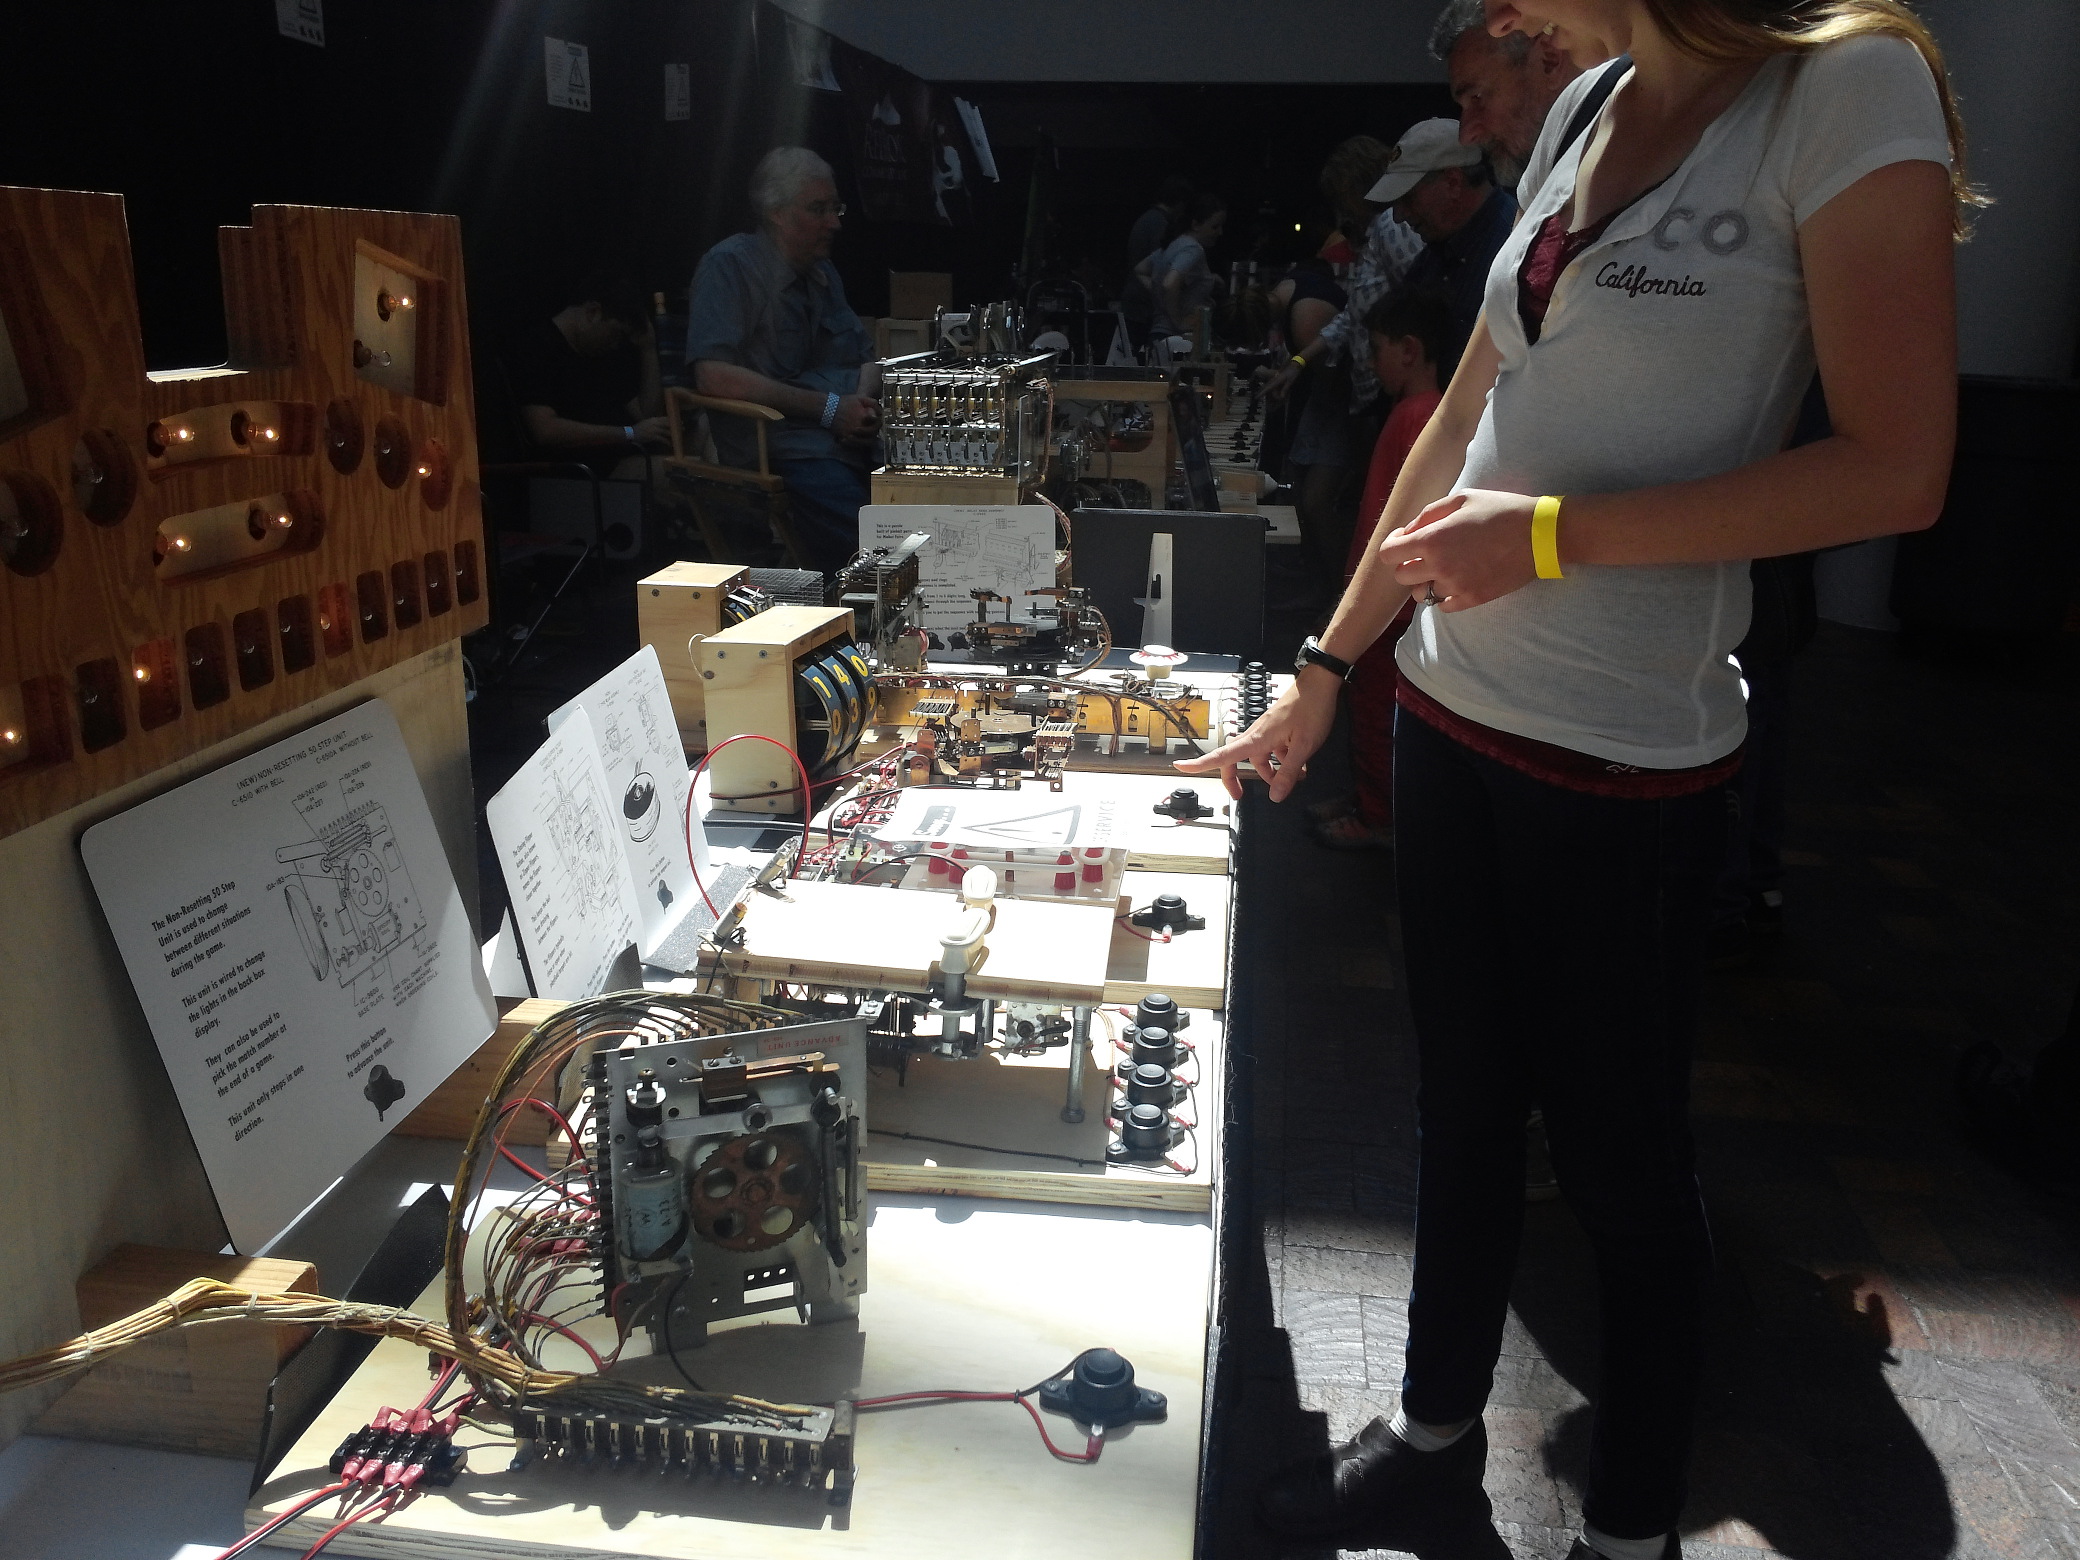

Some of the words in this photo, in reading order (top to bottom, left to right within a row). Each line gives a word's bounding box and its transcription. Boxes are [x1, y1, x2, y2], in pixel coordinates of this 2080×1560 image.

[1595, 261, 1706, 298] California
[832, 664, 850, 685] 4
[850, 655, 868, 677] 0
[257, 750, 307, 780] NON-RESETTING
[308, 745, 317, 755] 50
[317, 737, 332, 750] STEP
[332, 730, 347, 743] UNIT
[338, 737, 360, 752] WITHOUT
[360, 733, 374, 742] BELL
[254, 783, 269, 795] WITH
[269, 777, 285, 788] BELL
[151, 920, 166, 932] The
[165, 894, 212, 925] Non-Resetting
[211, 886, 221, 899] 50
[220, 881, 236, 893] Step
[158, 933, 174, 947] Unit
[173, 929, 182, 938] is
[181, 917, 198, 934] used
[197, 916, 206, 925] to
[206, 903, 228, 920] change
[163, 941, 193, 963] between
[193, 923, 221, 946] different
[221, 907, 251, 929] situations
[171, 960, 194, 978] during
[193, 953, 205, 964] the
[205, 941, 226, 959] game.
[181, 994, 197, 1008] This
[197, 985, 211, 999] unit
[210, 980, 218, 990] is
[218, 967, 237, 985] wired
[236, 965, 244, 973] to
[244, 951, 266, 968] change
[188, 1012, 200, 1023] the
[199, 998, 220, 1016] lights
[218, 993, 227, 1003] in
[227, 987, 238, 998] the
[237, 975, 254, 990] back
[252, 969, 266, 980] box
[357, 1005, 370, 1018] BASE
[369, 993, 385, 1007] PLATE
[195, 1018, 221, 1038] display.
[205, 1053, 222, 1068] They
[224, 1043, 236, 1056] can
[236, 1033, 250, 1047] also
[249, 1027, 258, 1037] be
[258, 1014, 273, 1031] used
[272, 1012, 280, 1020] to
[345, 1048, 361, 1063] Press
[360, 1040, 371, 1051] this
[369, 1027, 387, 1043] button
[768, 1042, 791, 1051] UNIT
[794, 1034, 841, 1047] ADVANCE
[212, 1067, 227, 1085] pick
[226, 1061, 238, 1072] the
[237, 1045, 257, 1064] match
[257, 1030, 279, 1050] number
[280, 1024, 287, 1034] at
[347, 1071, 354, 1079] to
[353, 1054, 374, 1074] advance
[373, 1047, 383, 1057] the
[217, 1086, 229, 1098] the
[229, 1073, 242, 1089] end
[242, 1067, 249, 1080] of
[250, 1066, 255, 1074] a
[255, 1053, 275, 1072] game.
[227, 1112, 243, 1127] This
[243, 1101, 256, 1116] unit
[256, 1091, 270, 1106] only
[270, 1079, 287, 1095] steps
[286, 1073, 293, 1082] in
[293, 1065, 305, 1077] one
[235, 1117, 264, 1142] direction.
